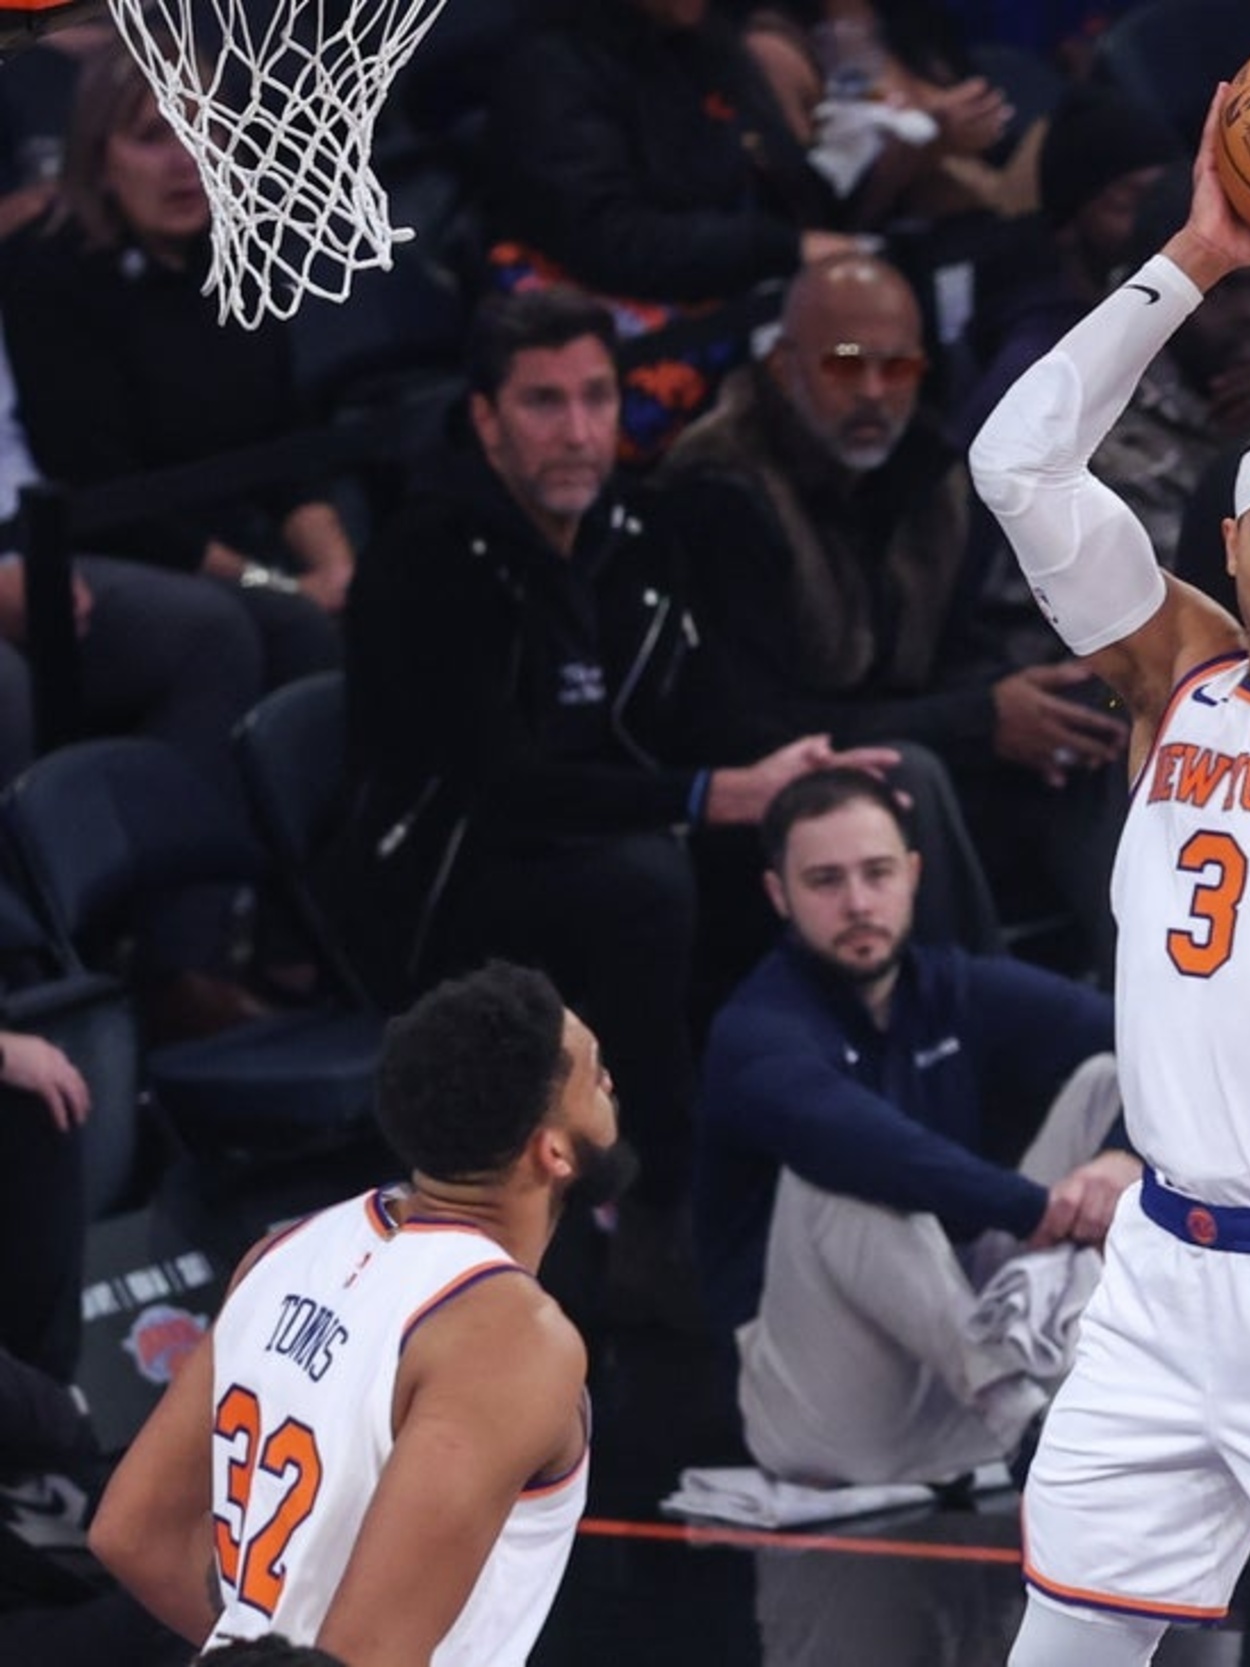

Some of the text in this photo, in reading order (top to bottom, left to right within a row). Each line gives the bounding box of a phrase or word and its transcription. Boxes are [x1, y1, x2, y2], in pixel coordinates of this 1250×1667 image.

[1146, 743, 1235, 808] EW
[1166, 829, 1248, 978] 3
[264, 1293, 349, 1384] TOWNS
[212, 1382, 323, 1618] 32
